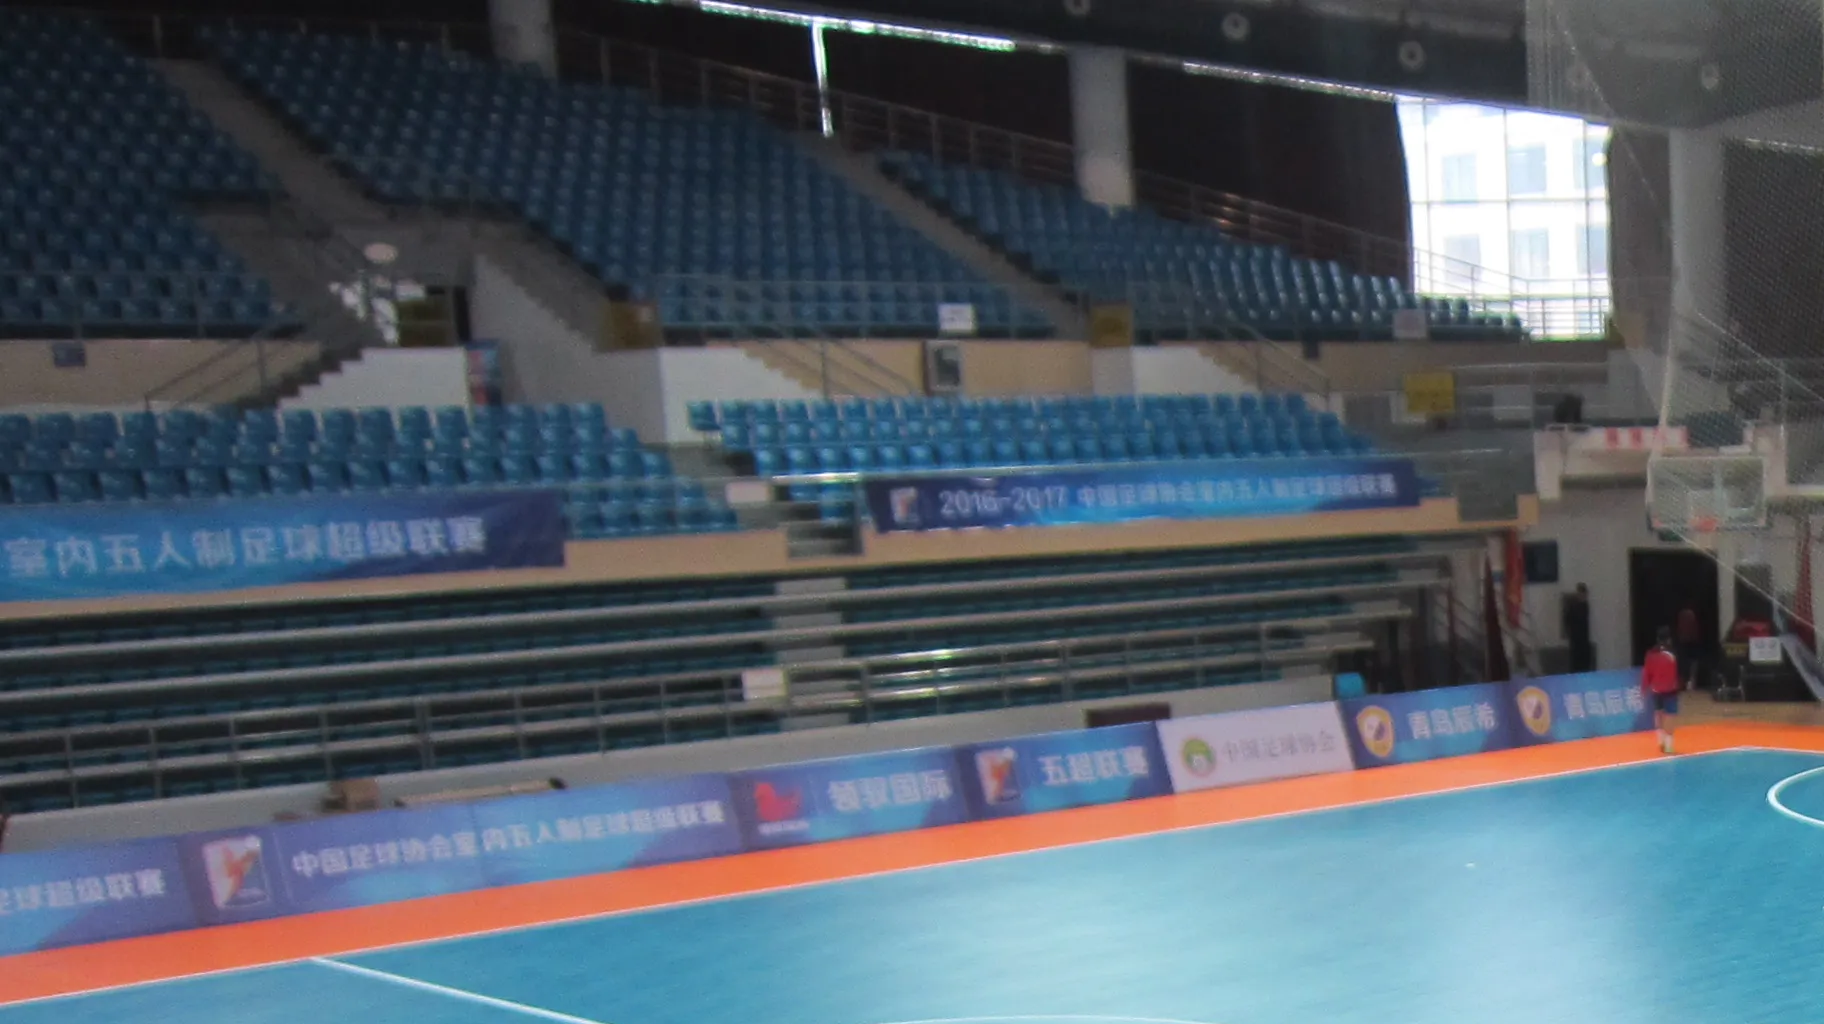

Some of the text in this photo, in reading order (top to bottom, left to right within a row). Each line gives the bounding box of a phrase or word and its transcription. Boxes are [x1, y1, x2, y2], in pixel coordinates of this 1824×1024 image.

[3, 516, 486, 577] 室内五人制足球超级联赛
[1407, 702, 1497, 740] 青岛辰希
[1562, 686, 1645, 720] 青岛辰希
